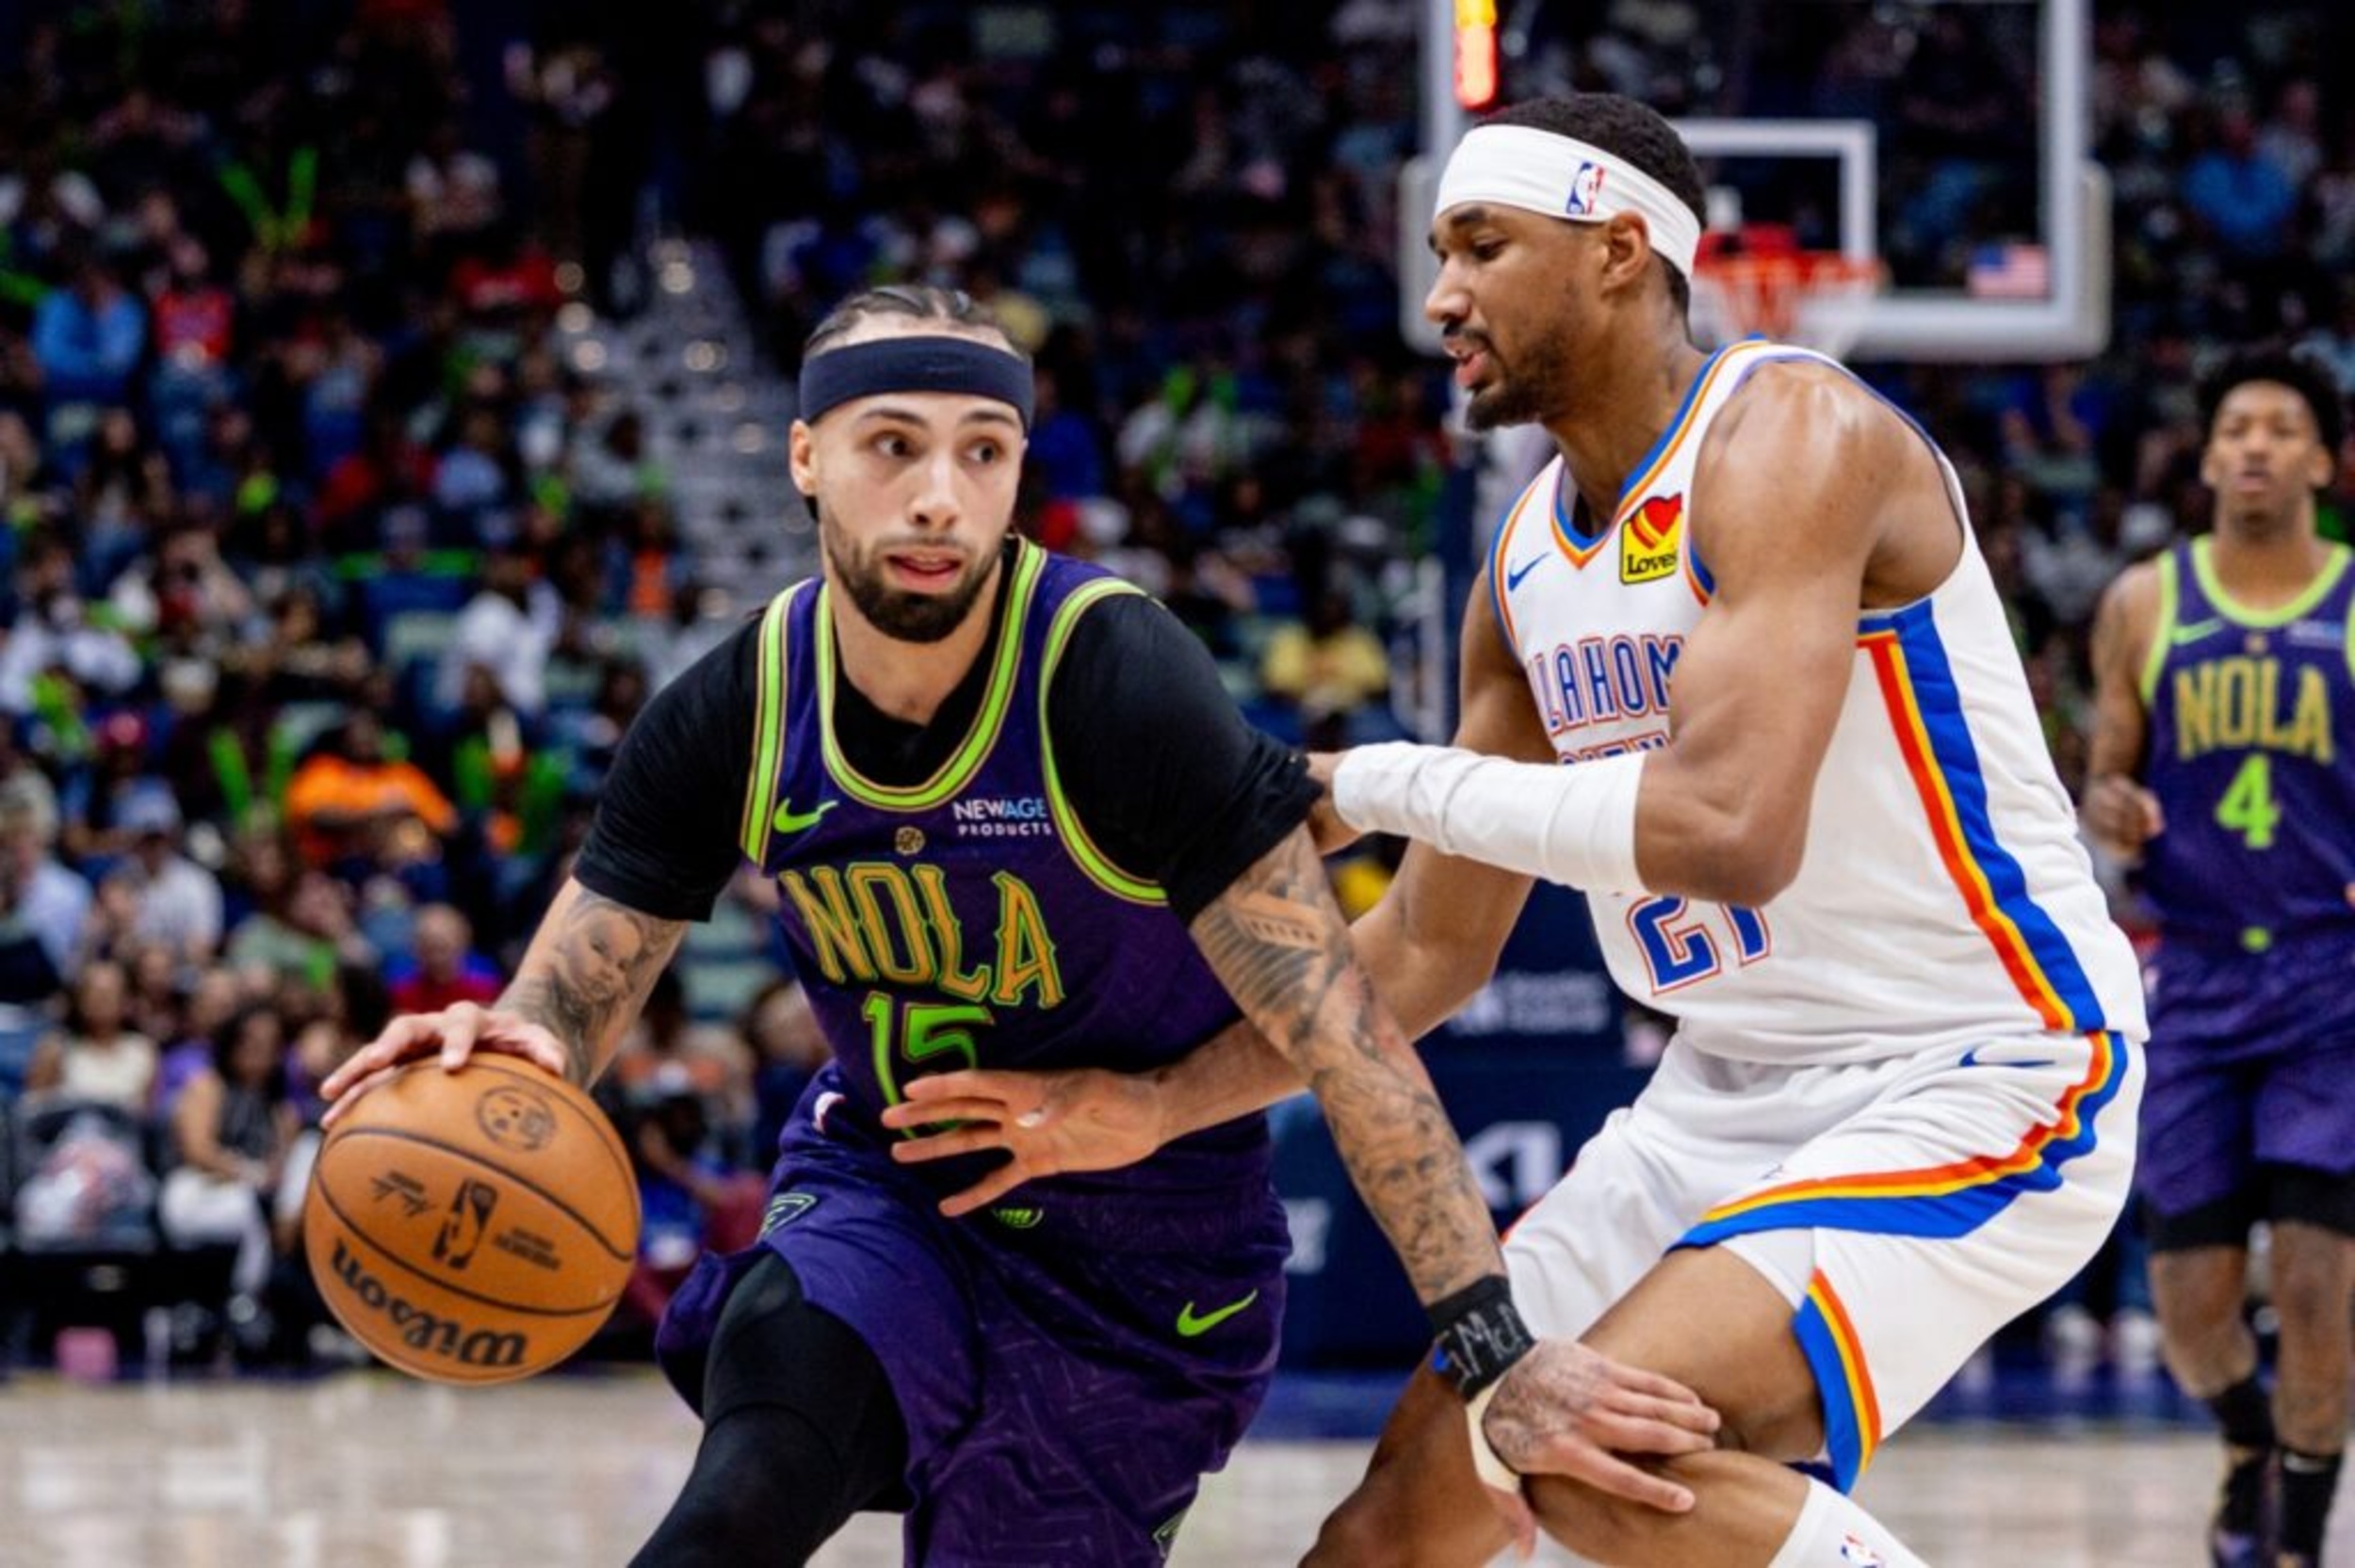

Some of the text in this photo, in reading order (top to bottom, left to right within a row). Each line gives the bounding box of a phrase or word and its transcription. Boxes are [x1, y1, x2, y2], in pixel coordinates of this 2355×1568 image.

[1533, 634, 1683, 736] LAHOM
[2175, 657, 2333, 765] NOLA
[952, 798, 1048, 820] NEWAGE
[958, 822, 1052, 836] PRODUCTS
[2216, 753, 2282, 849] 4
[777, 862, 1066, 1010] NOLA
[862, 990, 995, 1140] 15
[330, 1236, 528, 1366] Wilson
